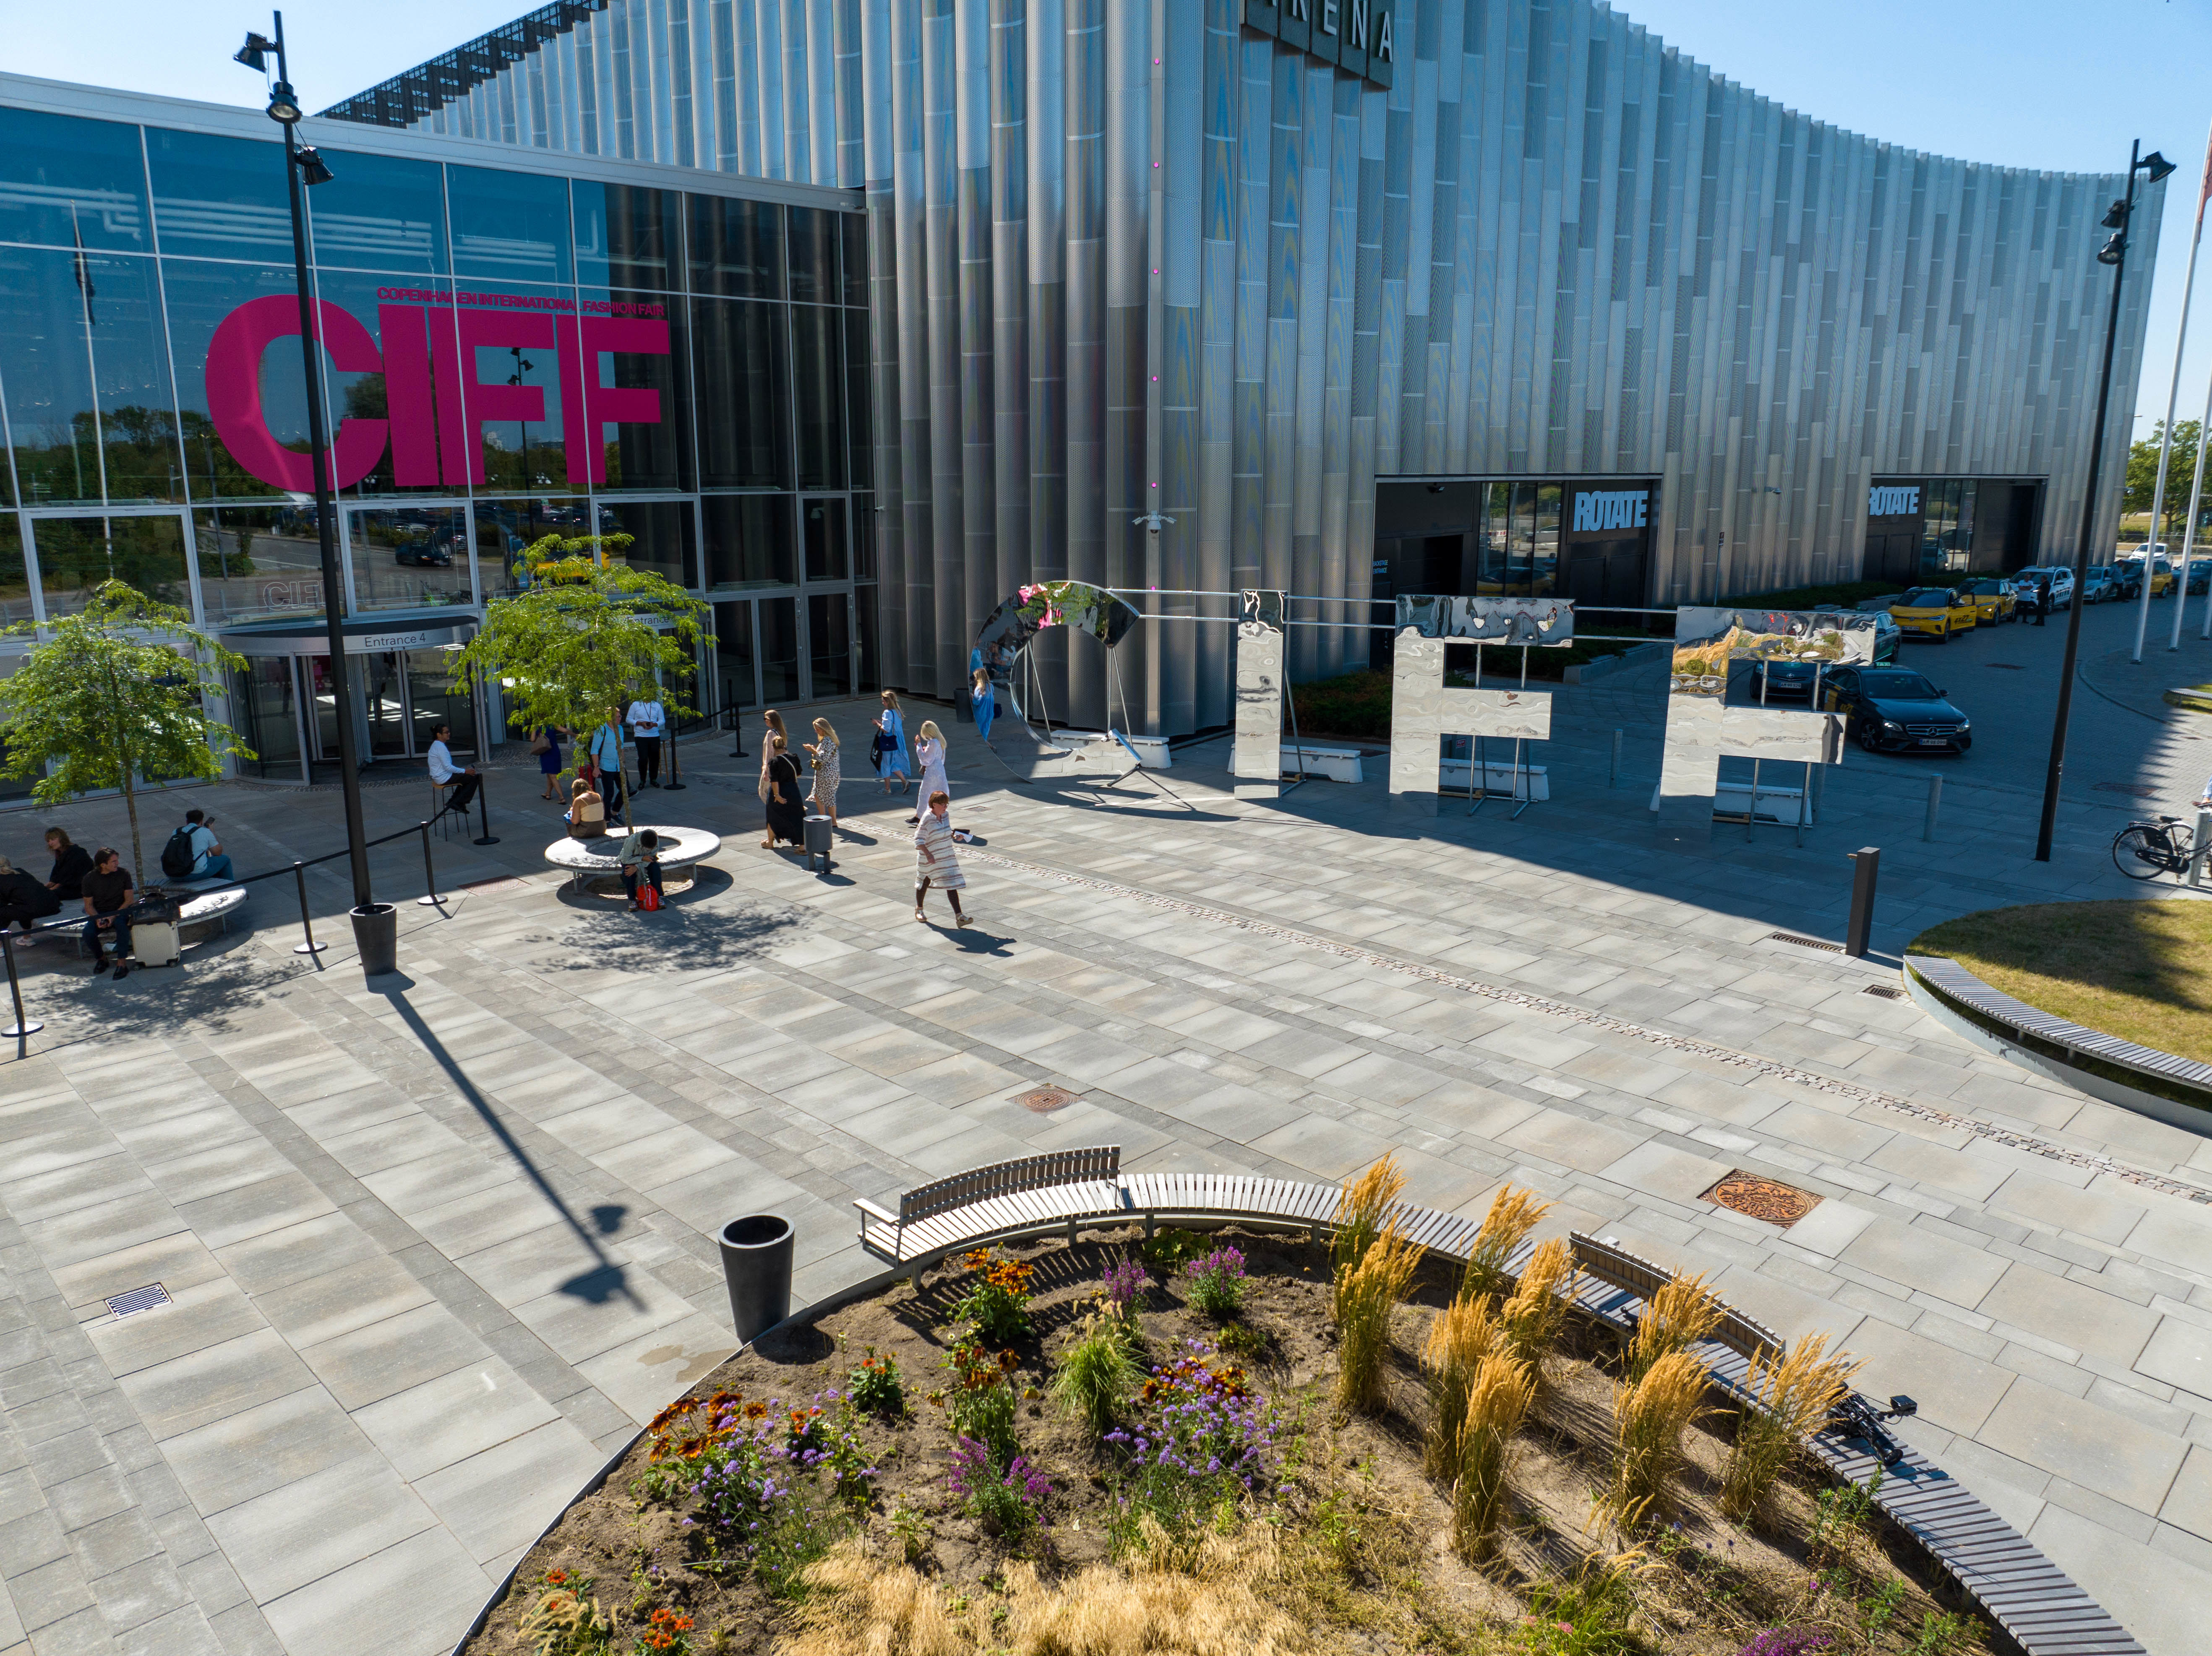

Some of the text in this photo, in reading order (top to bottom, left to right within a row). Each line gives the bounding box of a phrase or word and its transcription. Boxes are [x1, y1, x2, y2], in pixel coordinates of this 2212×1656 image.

[1270, 0, 1393, 63] ENA
[377, 286, 477, 305] COPENHAGEN
[583, 300, 637, 315] FASHION
[638, 304, 665, 316] FAIR
[205, 294, 670, 493] CIFF
[1573, 490, 1649, 532] ROTATE
[365, 633, 426, 647] Entrance 4
